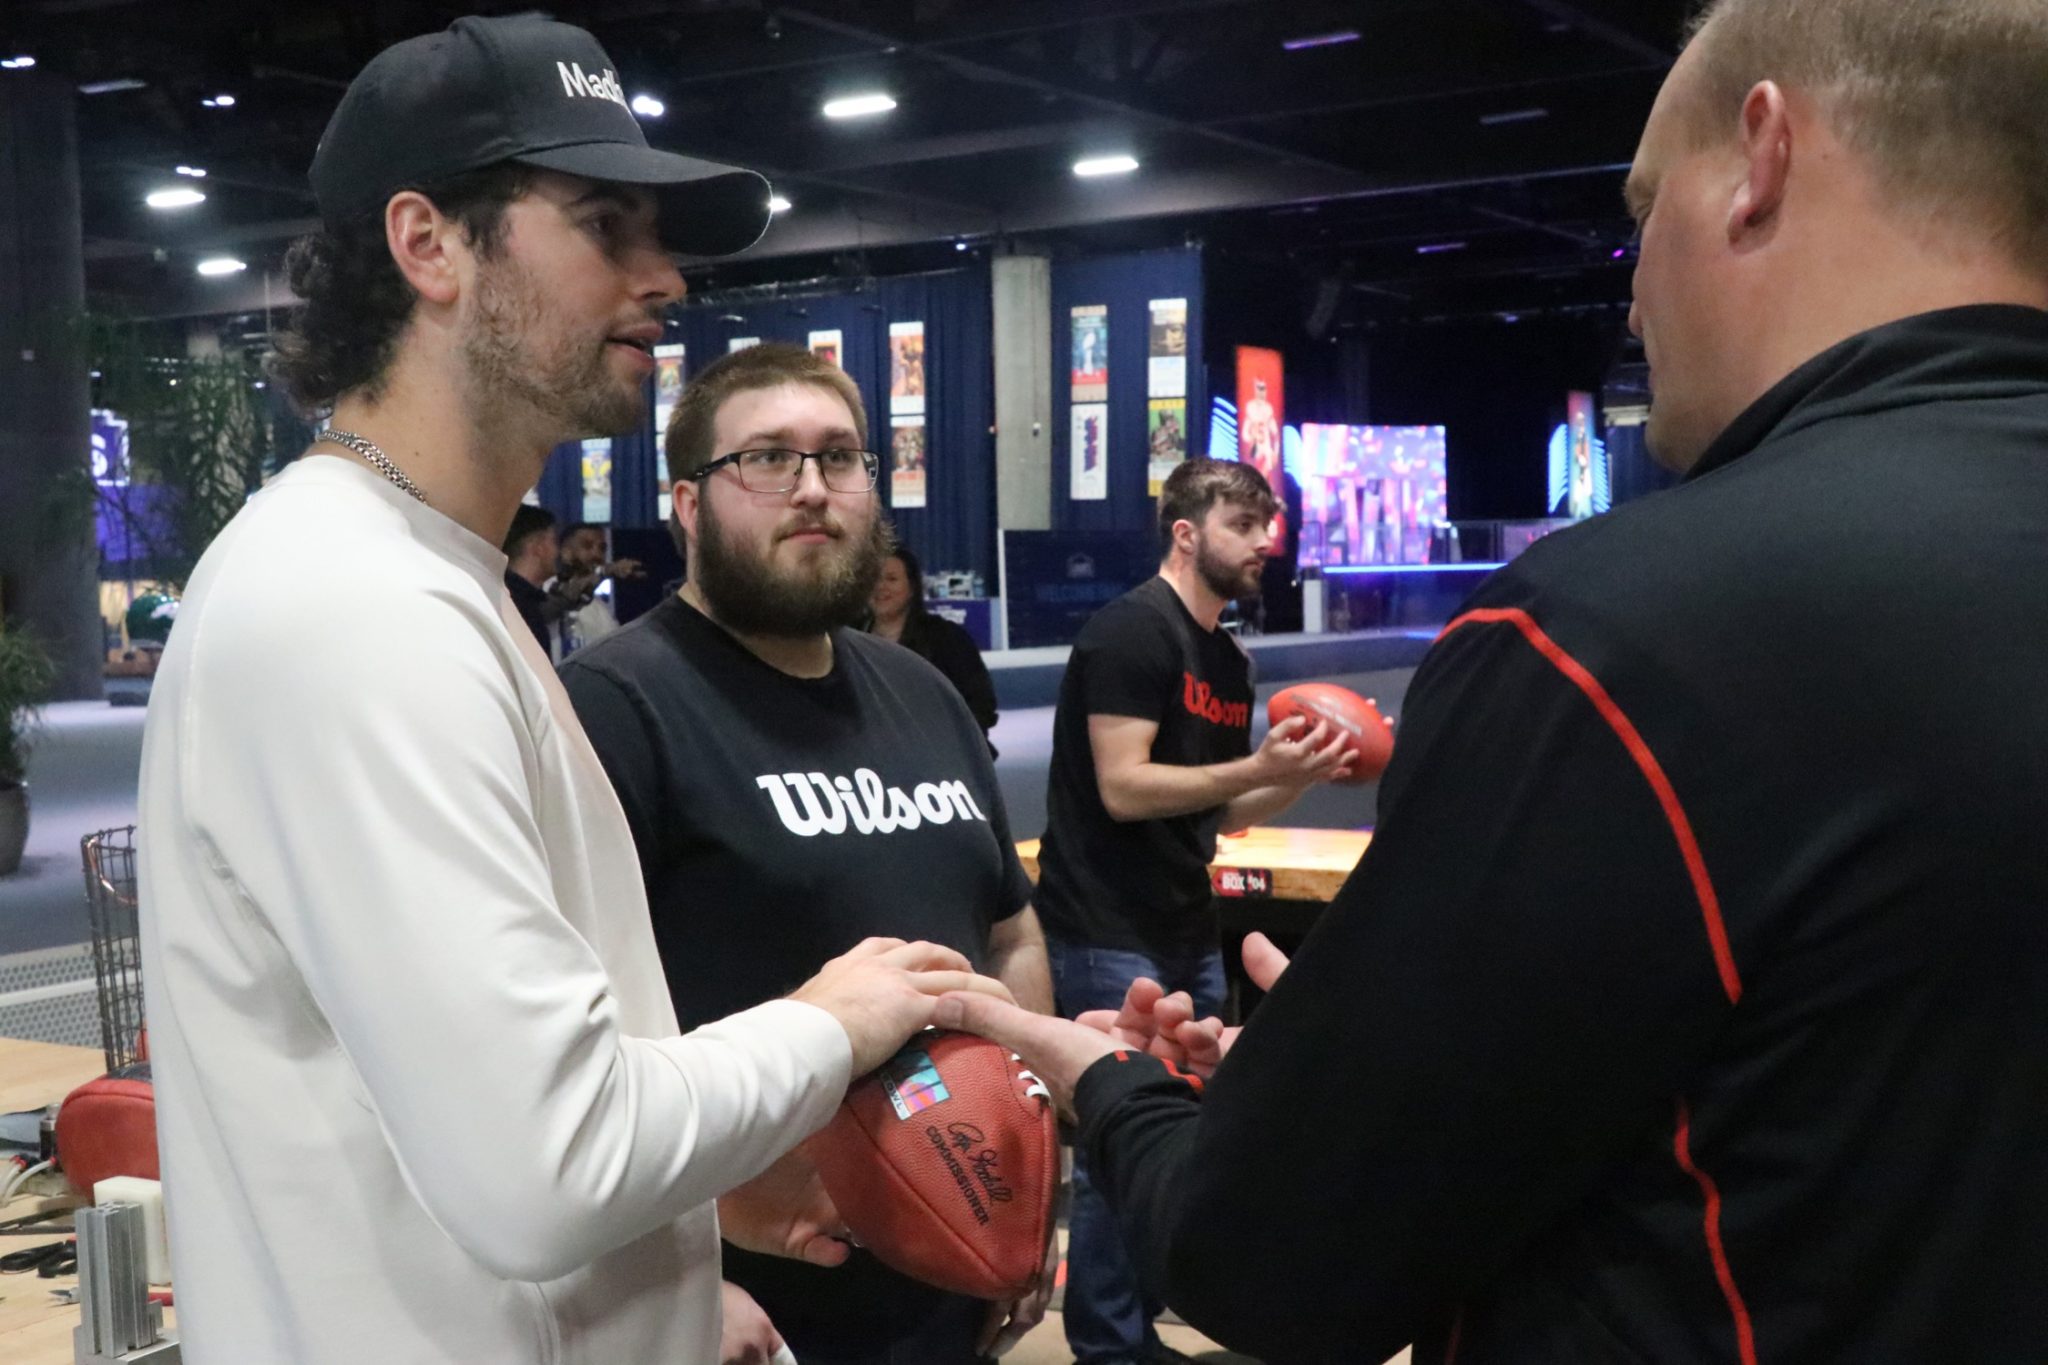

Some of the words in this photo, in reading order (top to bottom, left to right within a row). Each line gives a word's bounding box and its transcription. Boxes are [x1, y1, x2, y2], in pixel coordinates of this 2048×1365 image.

[755, 767, 987, 837] Wilson
[1222, 871, 1245, 890] BOX
[926, 1126, 989, 1225] COMMISSIONER
